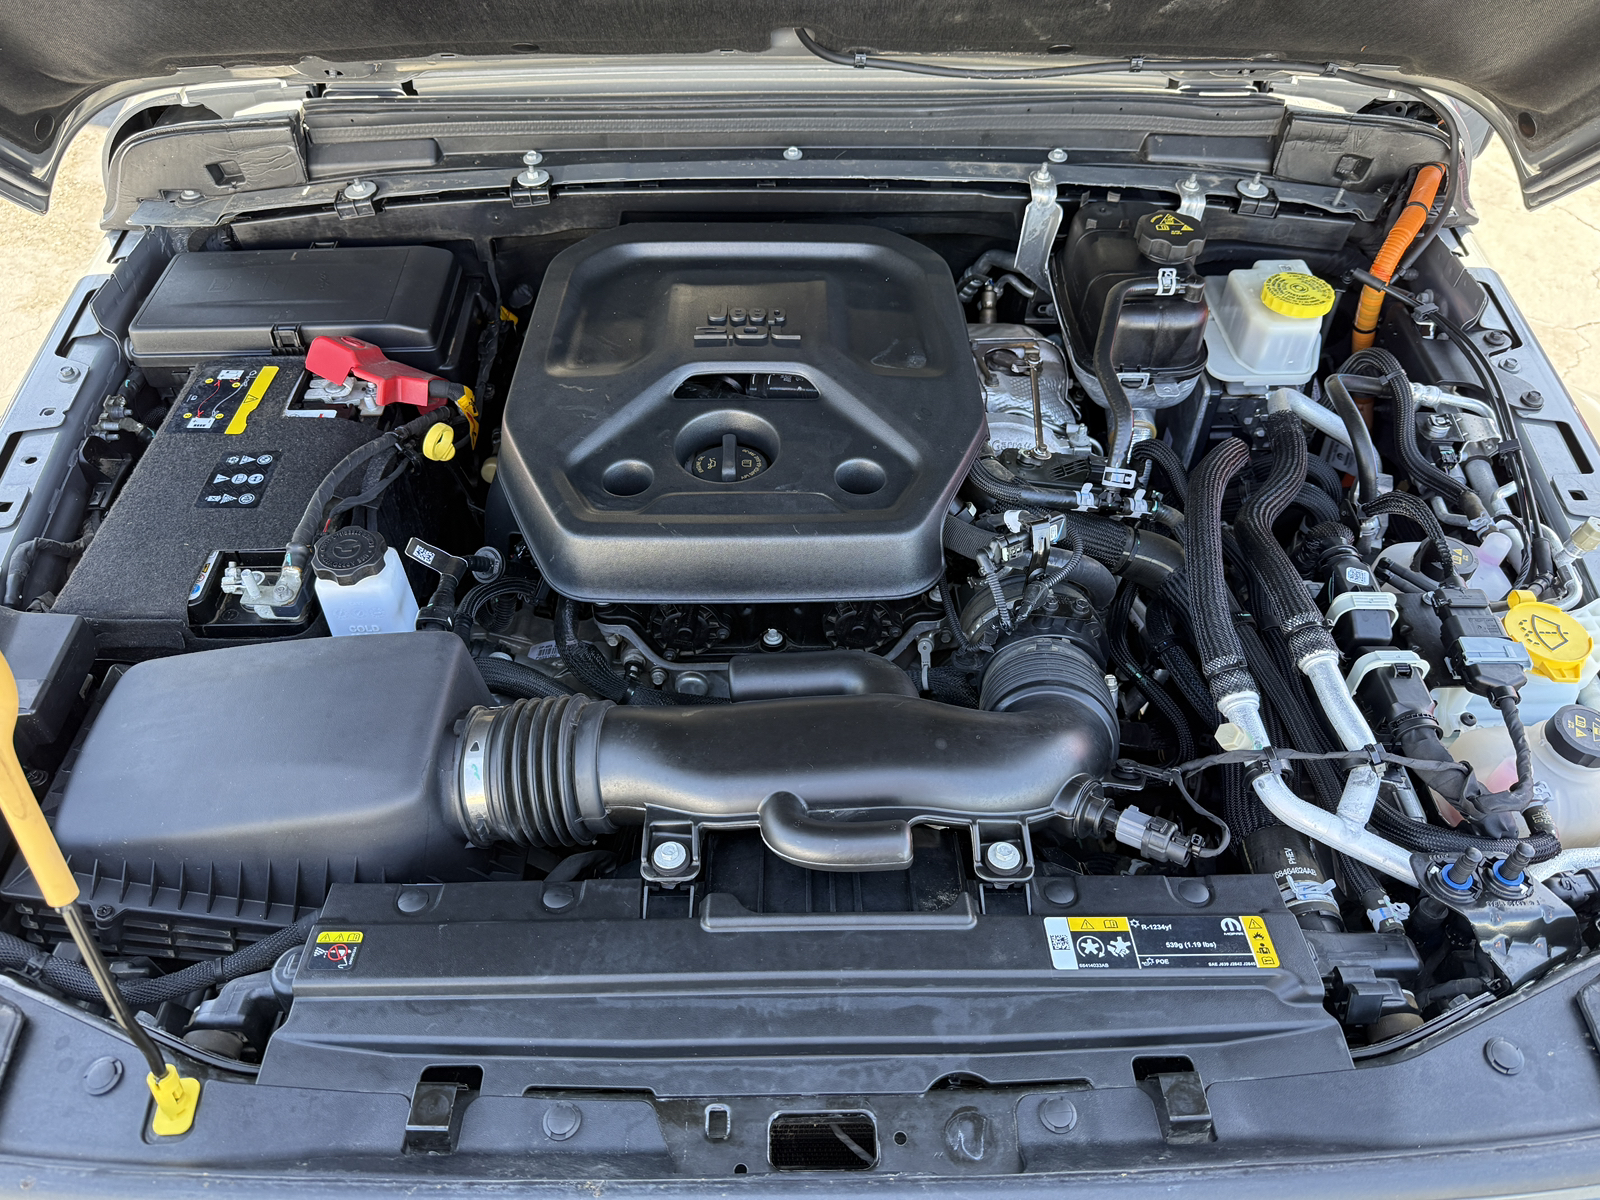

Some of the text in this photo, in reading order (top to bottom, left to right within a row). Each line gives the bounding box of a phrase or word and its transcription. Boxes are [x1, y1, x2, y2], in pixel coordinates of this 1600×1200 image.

[707, 302, 787, 325] Jeep
[694, 325, 801, 340] 2.0L
[349, 625, 381, 633] COLD
[1166, 941, 1217, 949] 539g (1.19 lbs)
